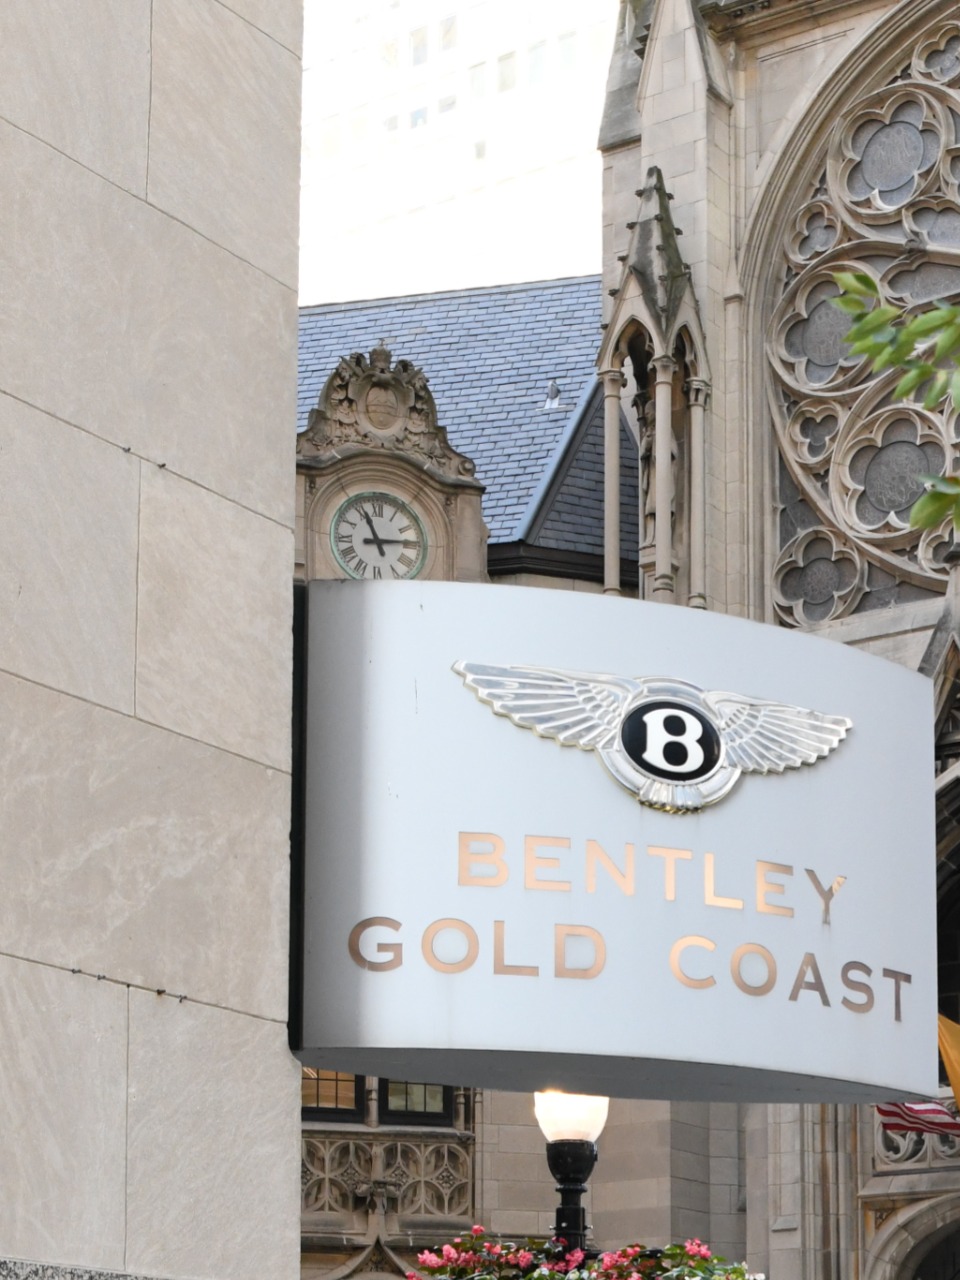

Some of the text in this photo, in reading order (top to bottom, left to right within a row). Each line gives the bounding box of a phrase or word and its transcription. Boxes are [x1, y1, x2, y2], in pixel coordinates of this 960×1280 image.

[643, 708, 704, 773] B
[457, 831, 848, 926] BENTLEY
[348, 916, 913, 1023] GOLD COAST
